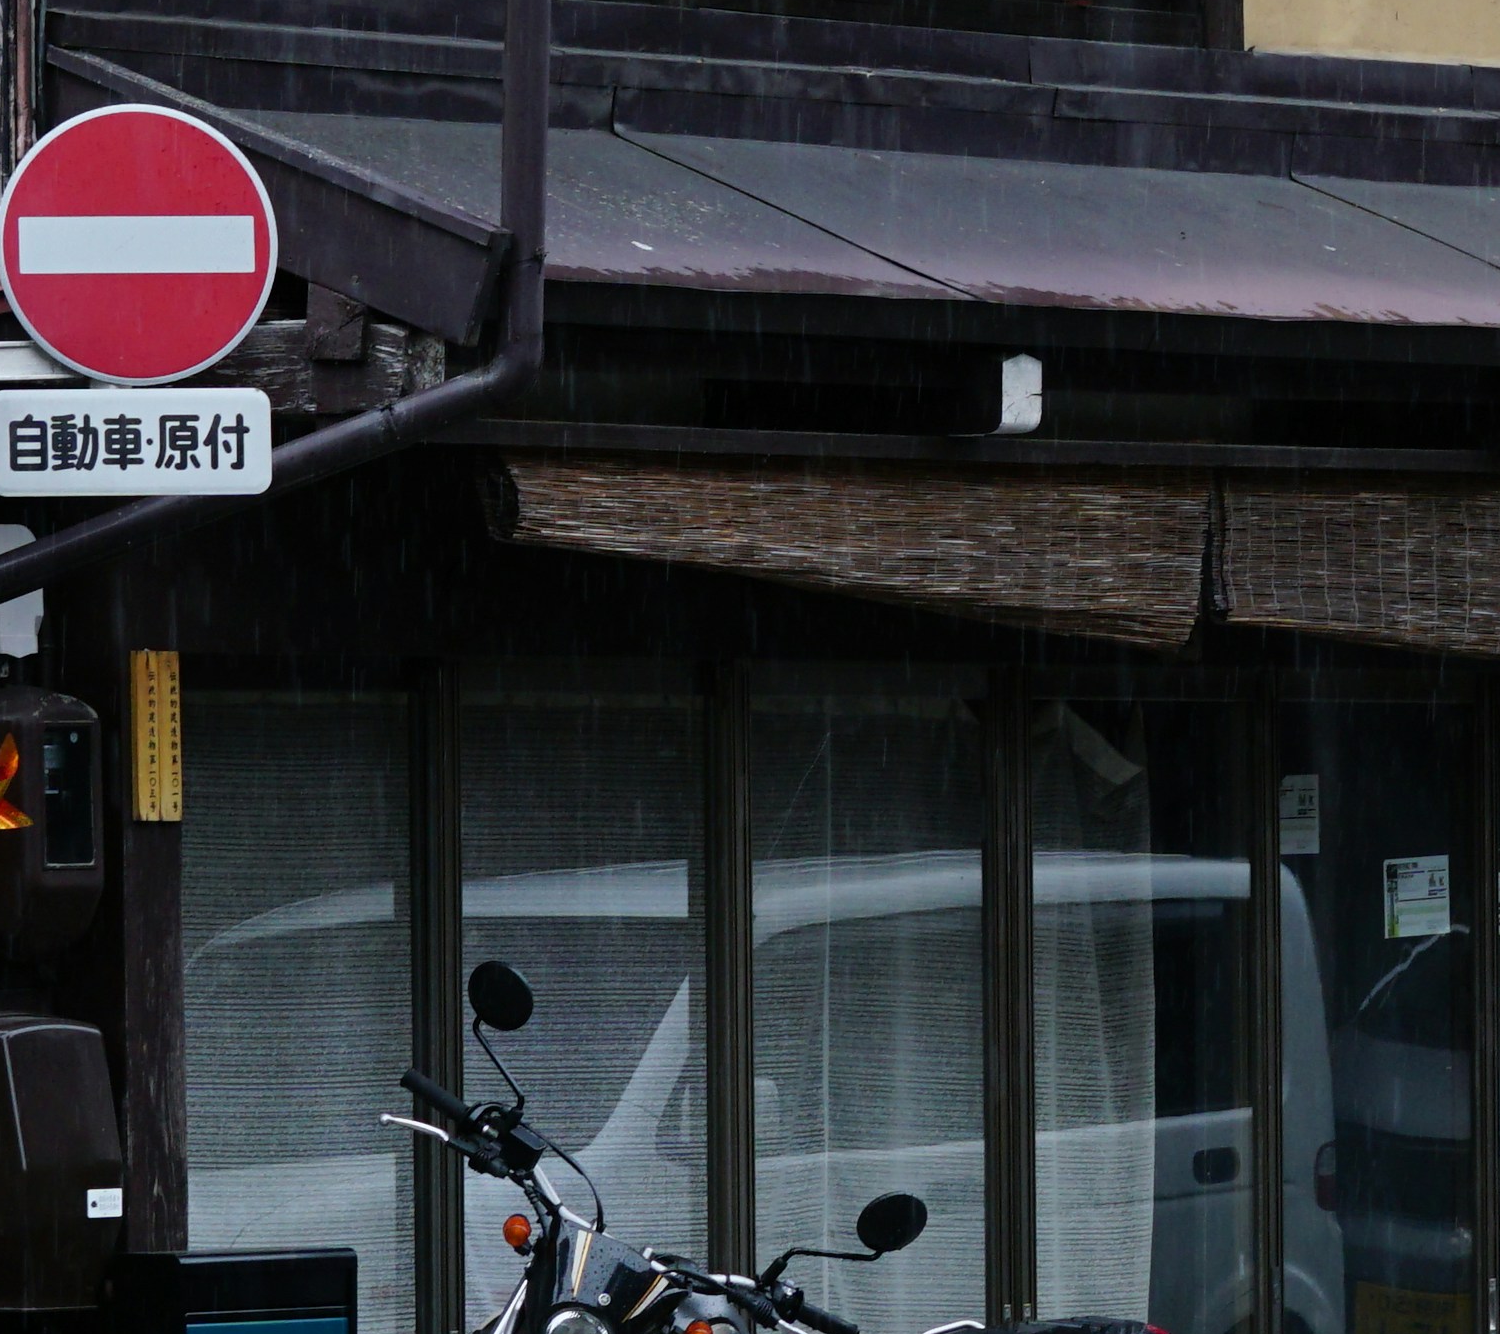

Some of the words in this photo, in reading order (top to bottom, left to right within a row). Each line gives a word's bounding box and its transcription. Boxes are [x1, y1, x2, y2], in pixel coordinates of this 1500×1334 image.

[9, 413, 249, 471] 自動車・原付
